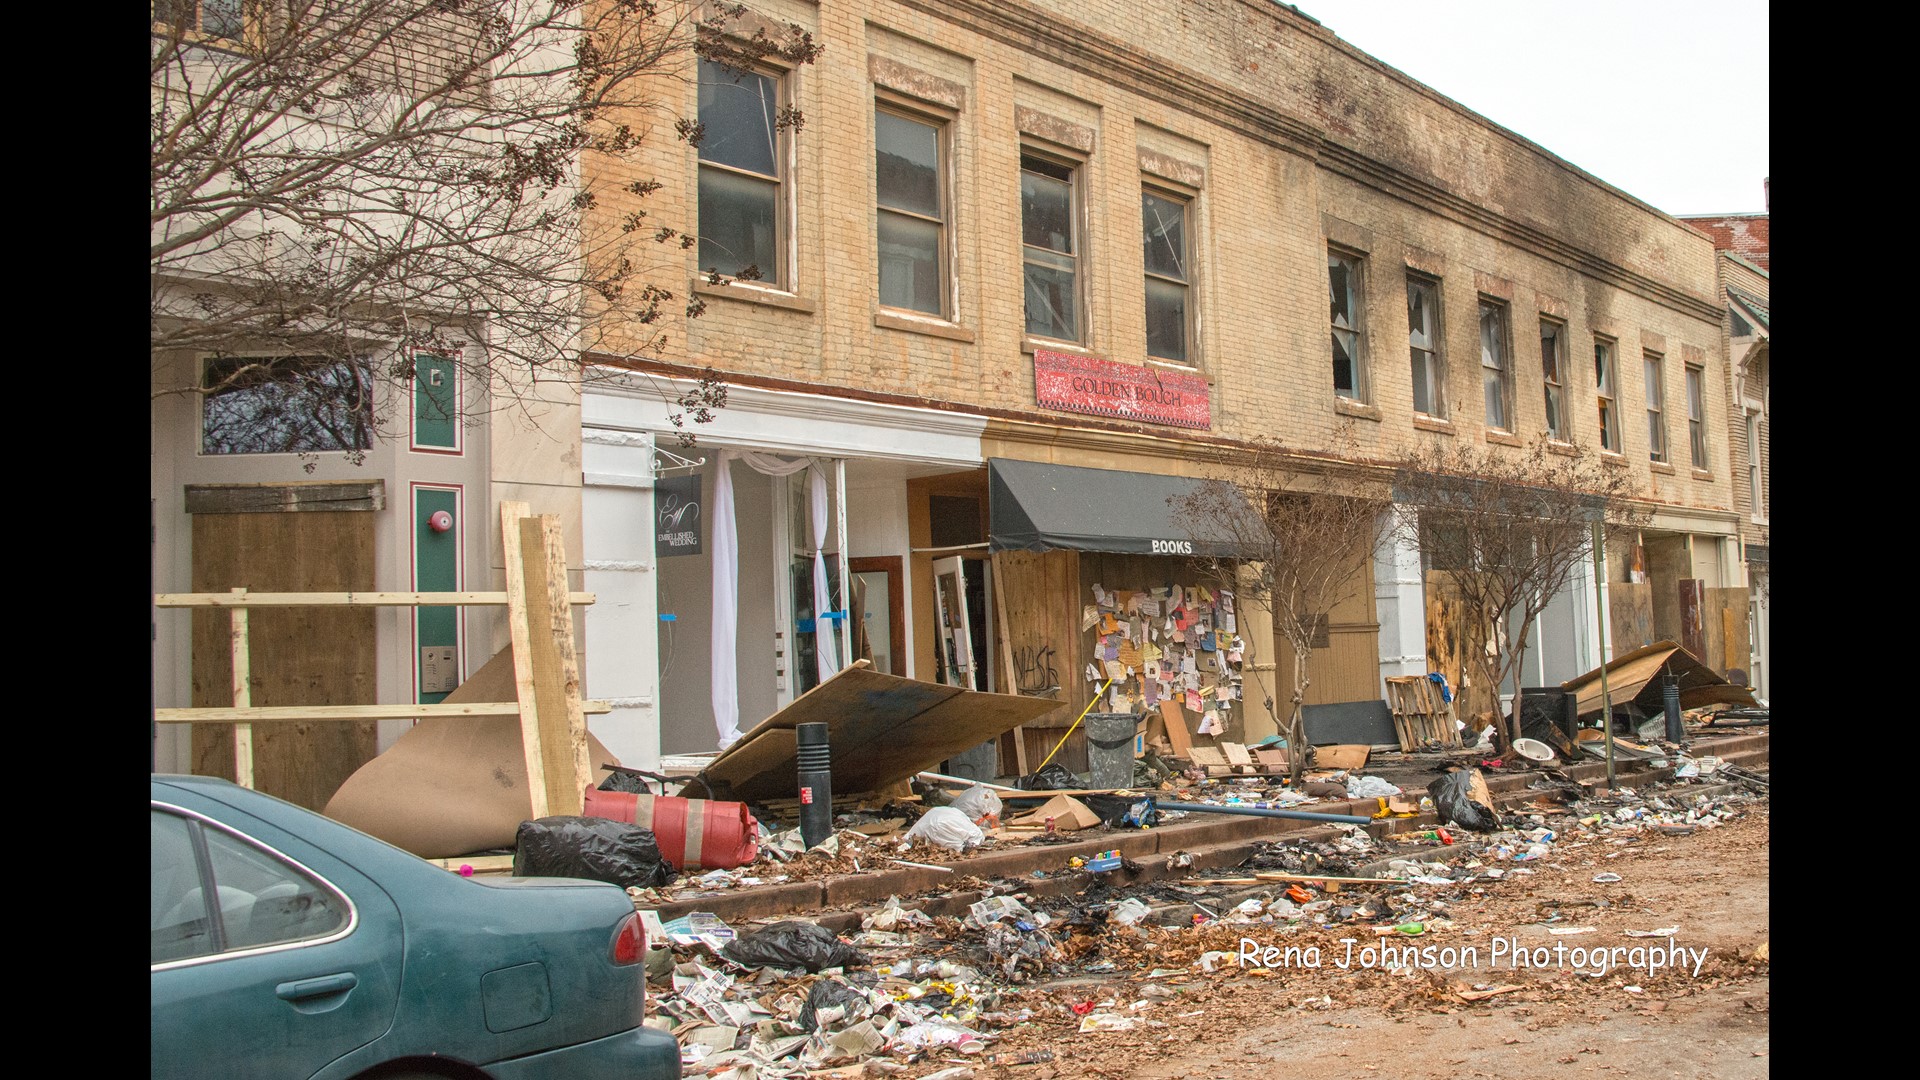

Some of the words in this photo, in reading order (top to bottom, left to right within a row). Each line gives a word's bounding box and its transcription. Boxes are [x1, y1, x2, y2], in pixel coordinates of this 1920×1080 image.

[1073, 376, 1130, 399] GOLDEN
[1135, 386, 1182, 406] BOUGH
[658, 531, 694, 542] EMBELLISHED
[669, 537, 697, 546] WEDDING
[1151, 539, 1193, 554] BOOKS
